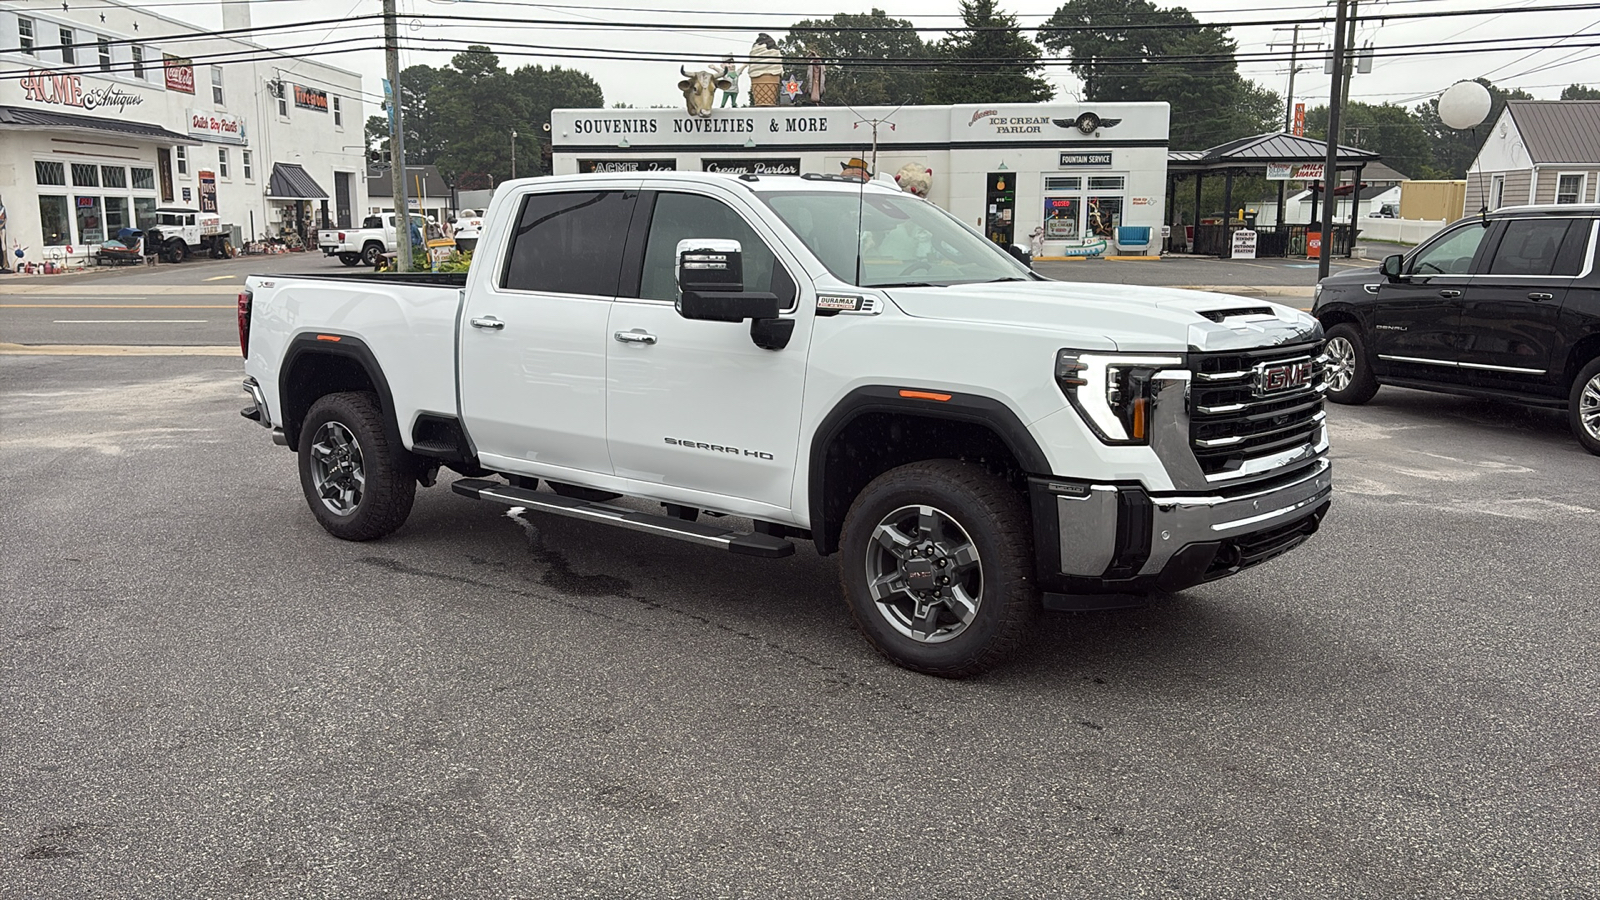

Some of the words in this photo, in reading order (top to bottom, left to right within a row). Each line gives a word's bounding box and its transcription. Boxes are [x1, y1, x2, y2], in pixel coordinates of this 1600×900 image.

[20, 68, 83, 108] ACME
[97, 82, 143, 114] Antiques
[293, 85, 328, 108] Firestone
[192, 114, 209, 130] Dutch
[209, 117, 221, 134] Boy
[220, 118, 238, 133] Paints
[574, 119, 658, 134] SOUVENIRS
[673, 118, 754, 133] NOVELTIES
[769, 119, 780, 133] &
[785, 117, 828, 132] MORE
[989, 117, 1008, 125] ICE
[1009, 116, 1050, 125] CREAM
[996, 126, 1041, 134] PARLOR
[1061, 155, 1088, 164] FOUNTAIN
[1088, 154, 1110, 163] SERVICE
[594, 162, 639, 173] ACME
[647, 162, 672, 172] Ice
[706, 162, 749, 174] Cream
[753, 162, 798, 174] Parlor
[1301, 163, 1325, 171] MILK
[1295, 170, 1323, 178] SHAKES
[203, 199, 216, 211] TEA
[1265, 361, 1312, 391] GMC
[664, 437, 740, 455] SIERRA
[743, 449, 774, 460] HD
